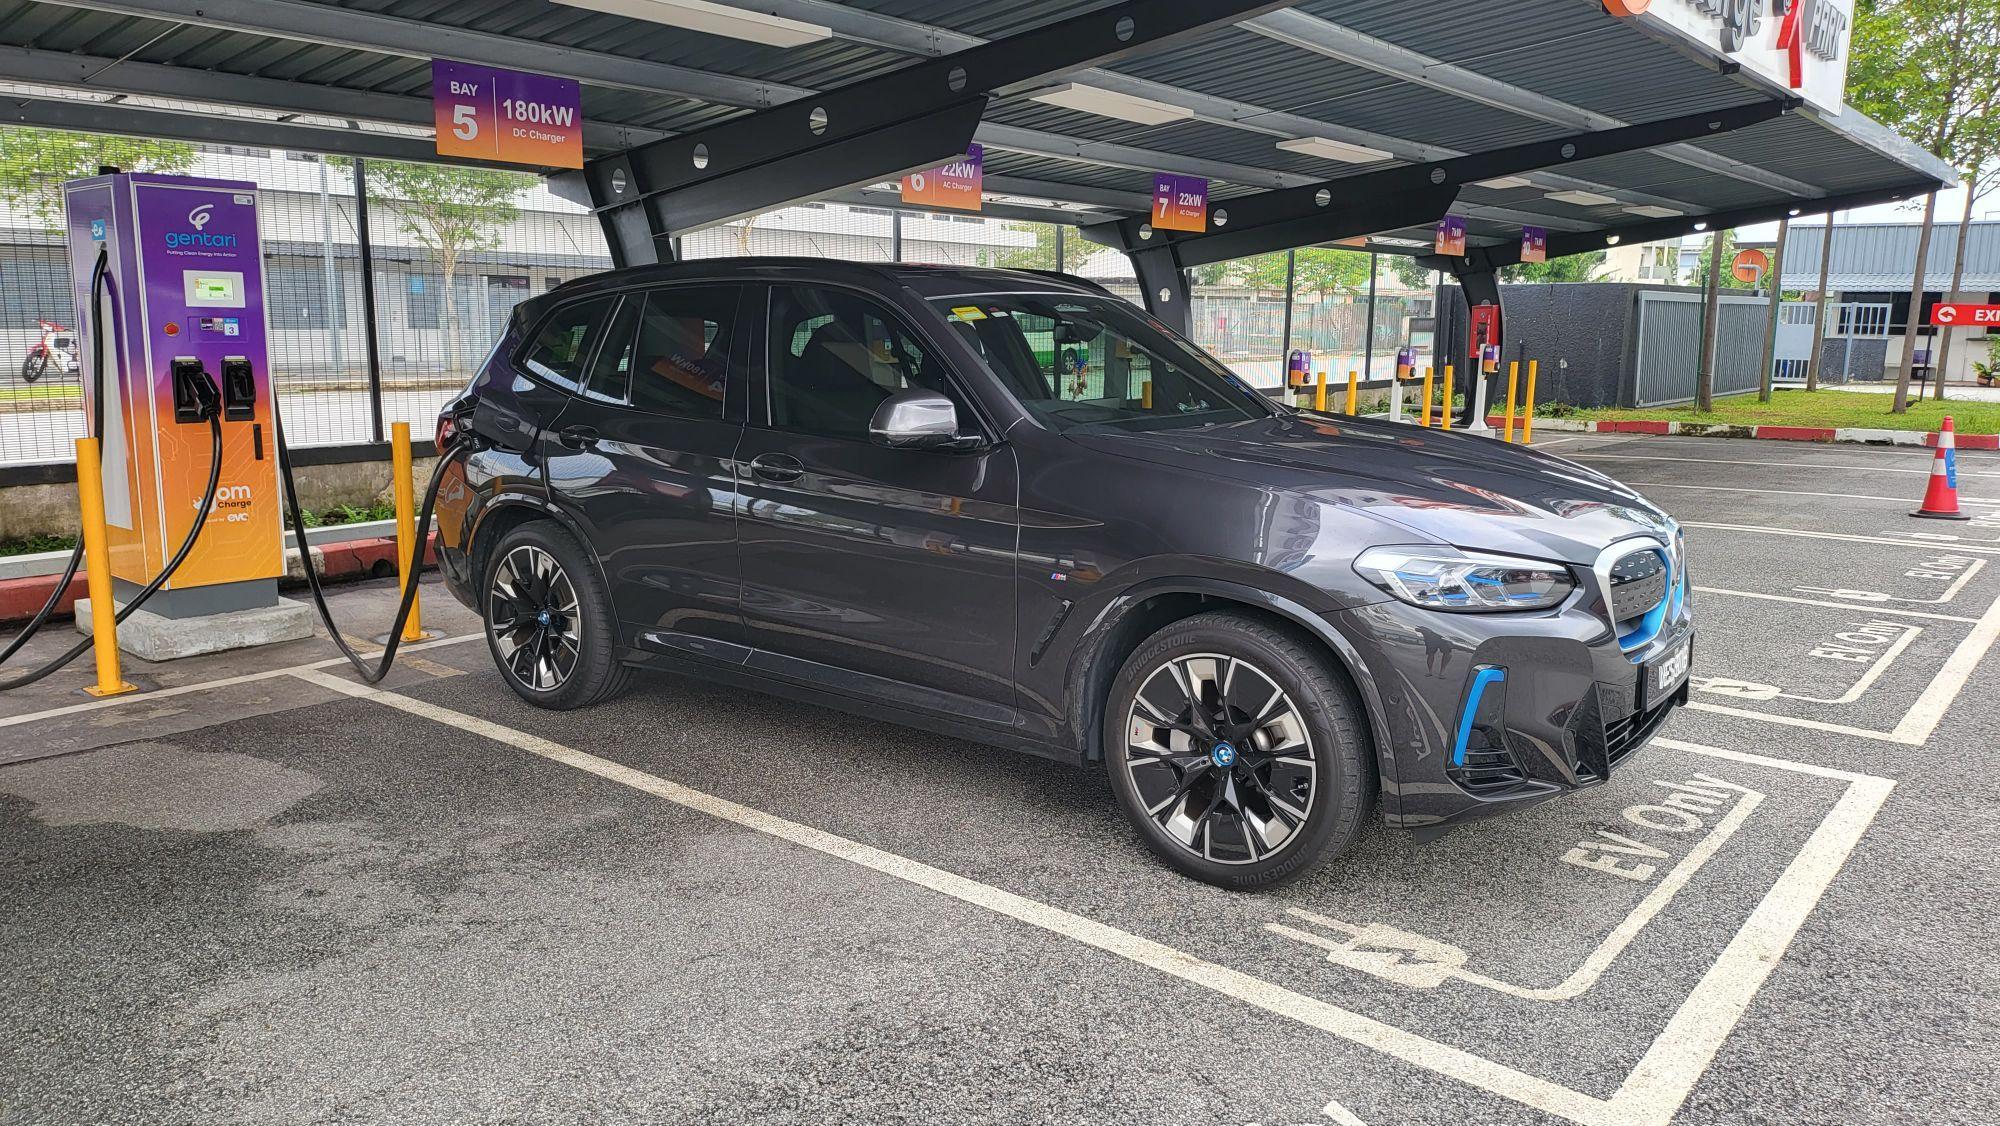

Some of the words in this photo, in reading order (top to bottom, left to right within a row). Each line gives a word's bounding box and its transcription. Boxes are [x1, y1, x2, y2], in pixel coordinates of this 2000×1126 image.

[450, 81, 478, 97] BAY
[502, 98, 574, 128] 180kW
[452, 104, 479, 141] 5
[513, 127, 527, 138] DC
[529, 129, 566, 144] Charger
[941, 162, 975, 179] 22kW
[910, 173, 925, 192] 6
[942, 181, 952, 190] AC
[951, 182, 973, 193] Charger
[1159, 184, 1170, 193] BAY
[1159, 197, 1169, 219] 7
[1179, 192, 1202, 207] 22kW
[165, 232, 236, 249] gentari
[1438, 231, 1445, 248] 9
[1522, 241, 1531, 256] 10
[228, 326, 235, 335] 3
[217, 500, 252, 509] Charge
[1807, 642, 1877, 663] EV
[1558, 830, 1671, 882] EV
[1621, 771, 1752, 833] Only
